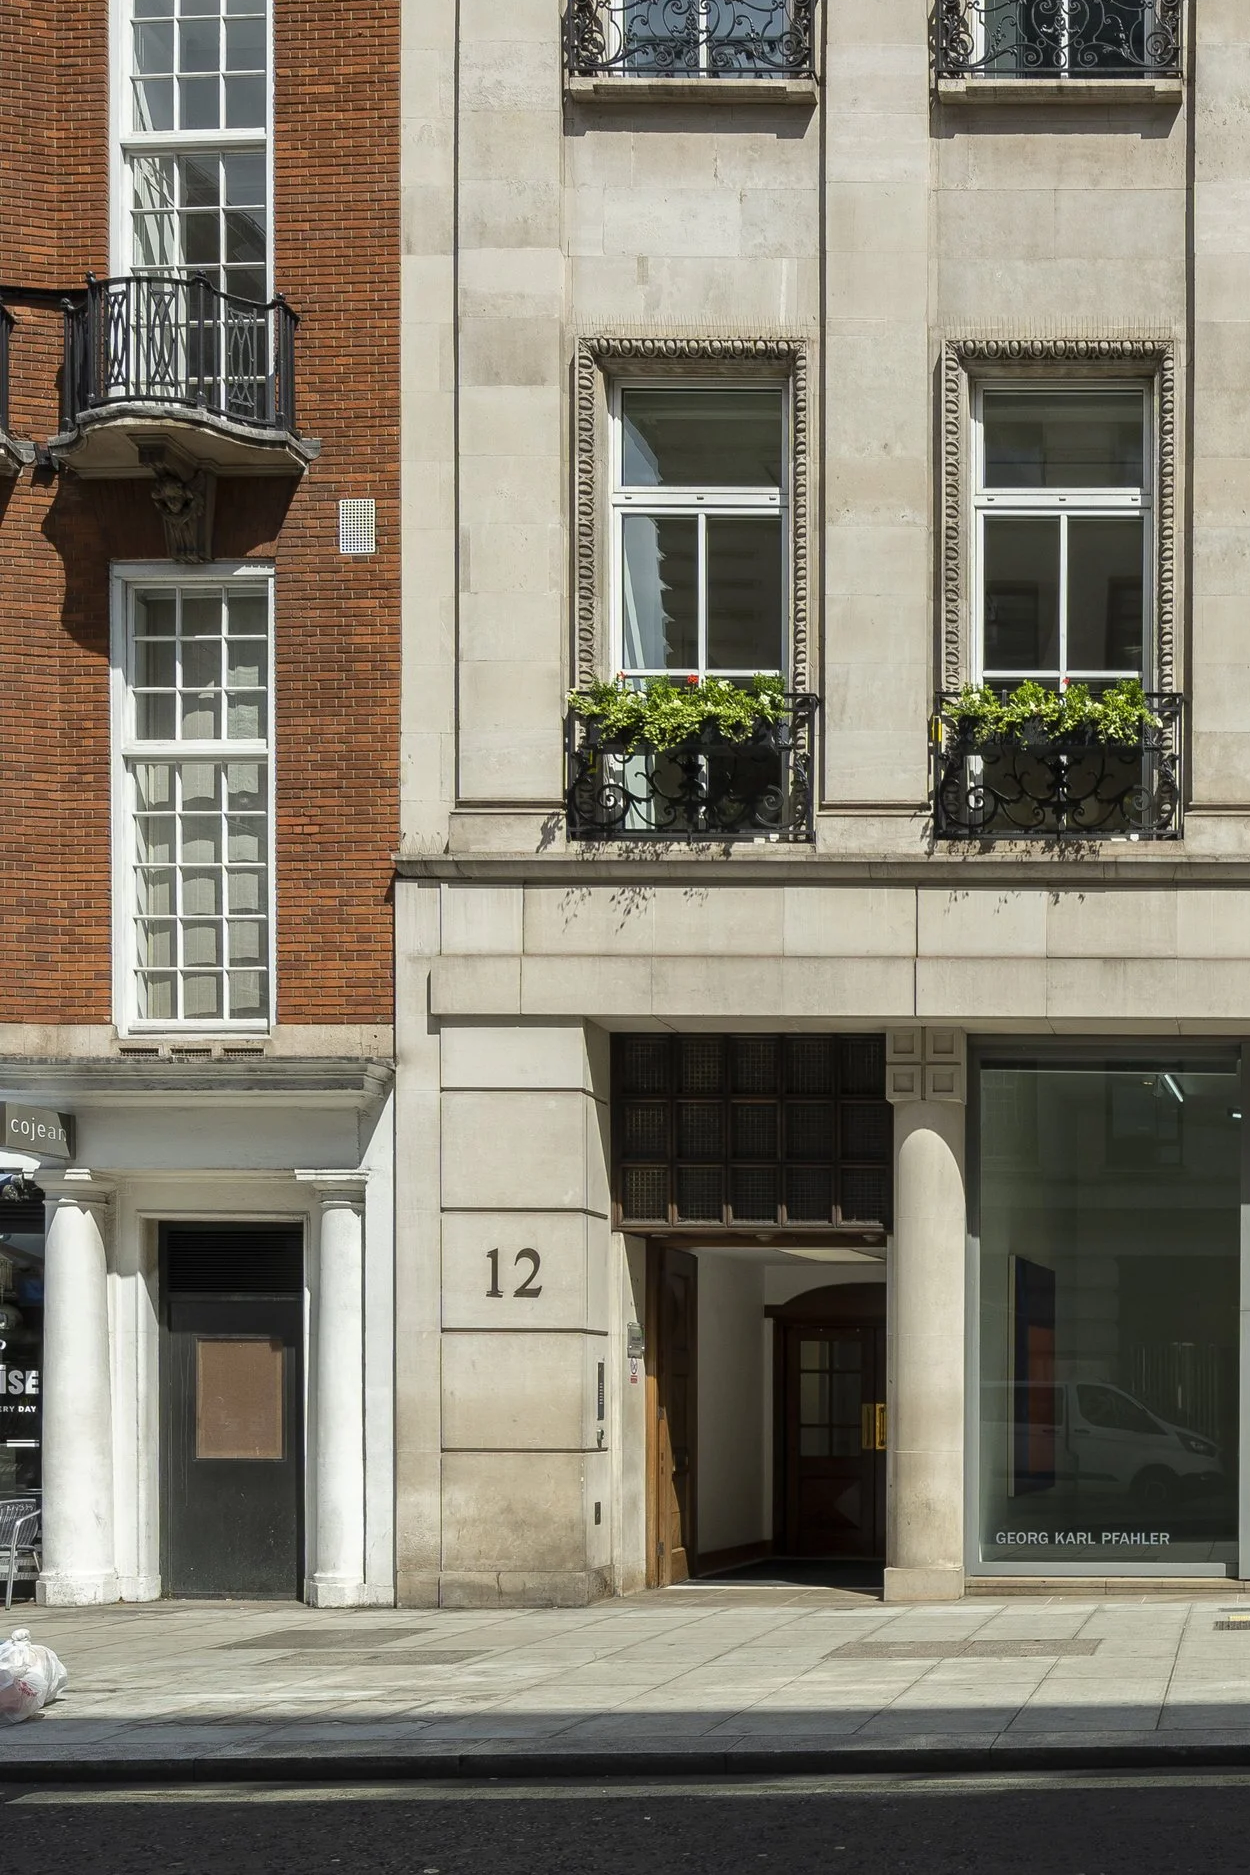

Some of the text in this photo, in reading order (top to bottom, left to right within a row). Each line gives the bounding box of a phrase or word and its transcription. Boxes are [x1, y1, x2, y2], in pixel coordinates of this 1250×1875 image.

[486, 1247, 543, 1298] 12
[995, 1532, 1170, 1545] GEORG KARL PFAHLER
